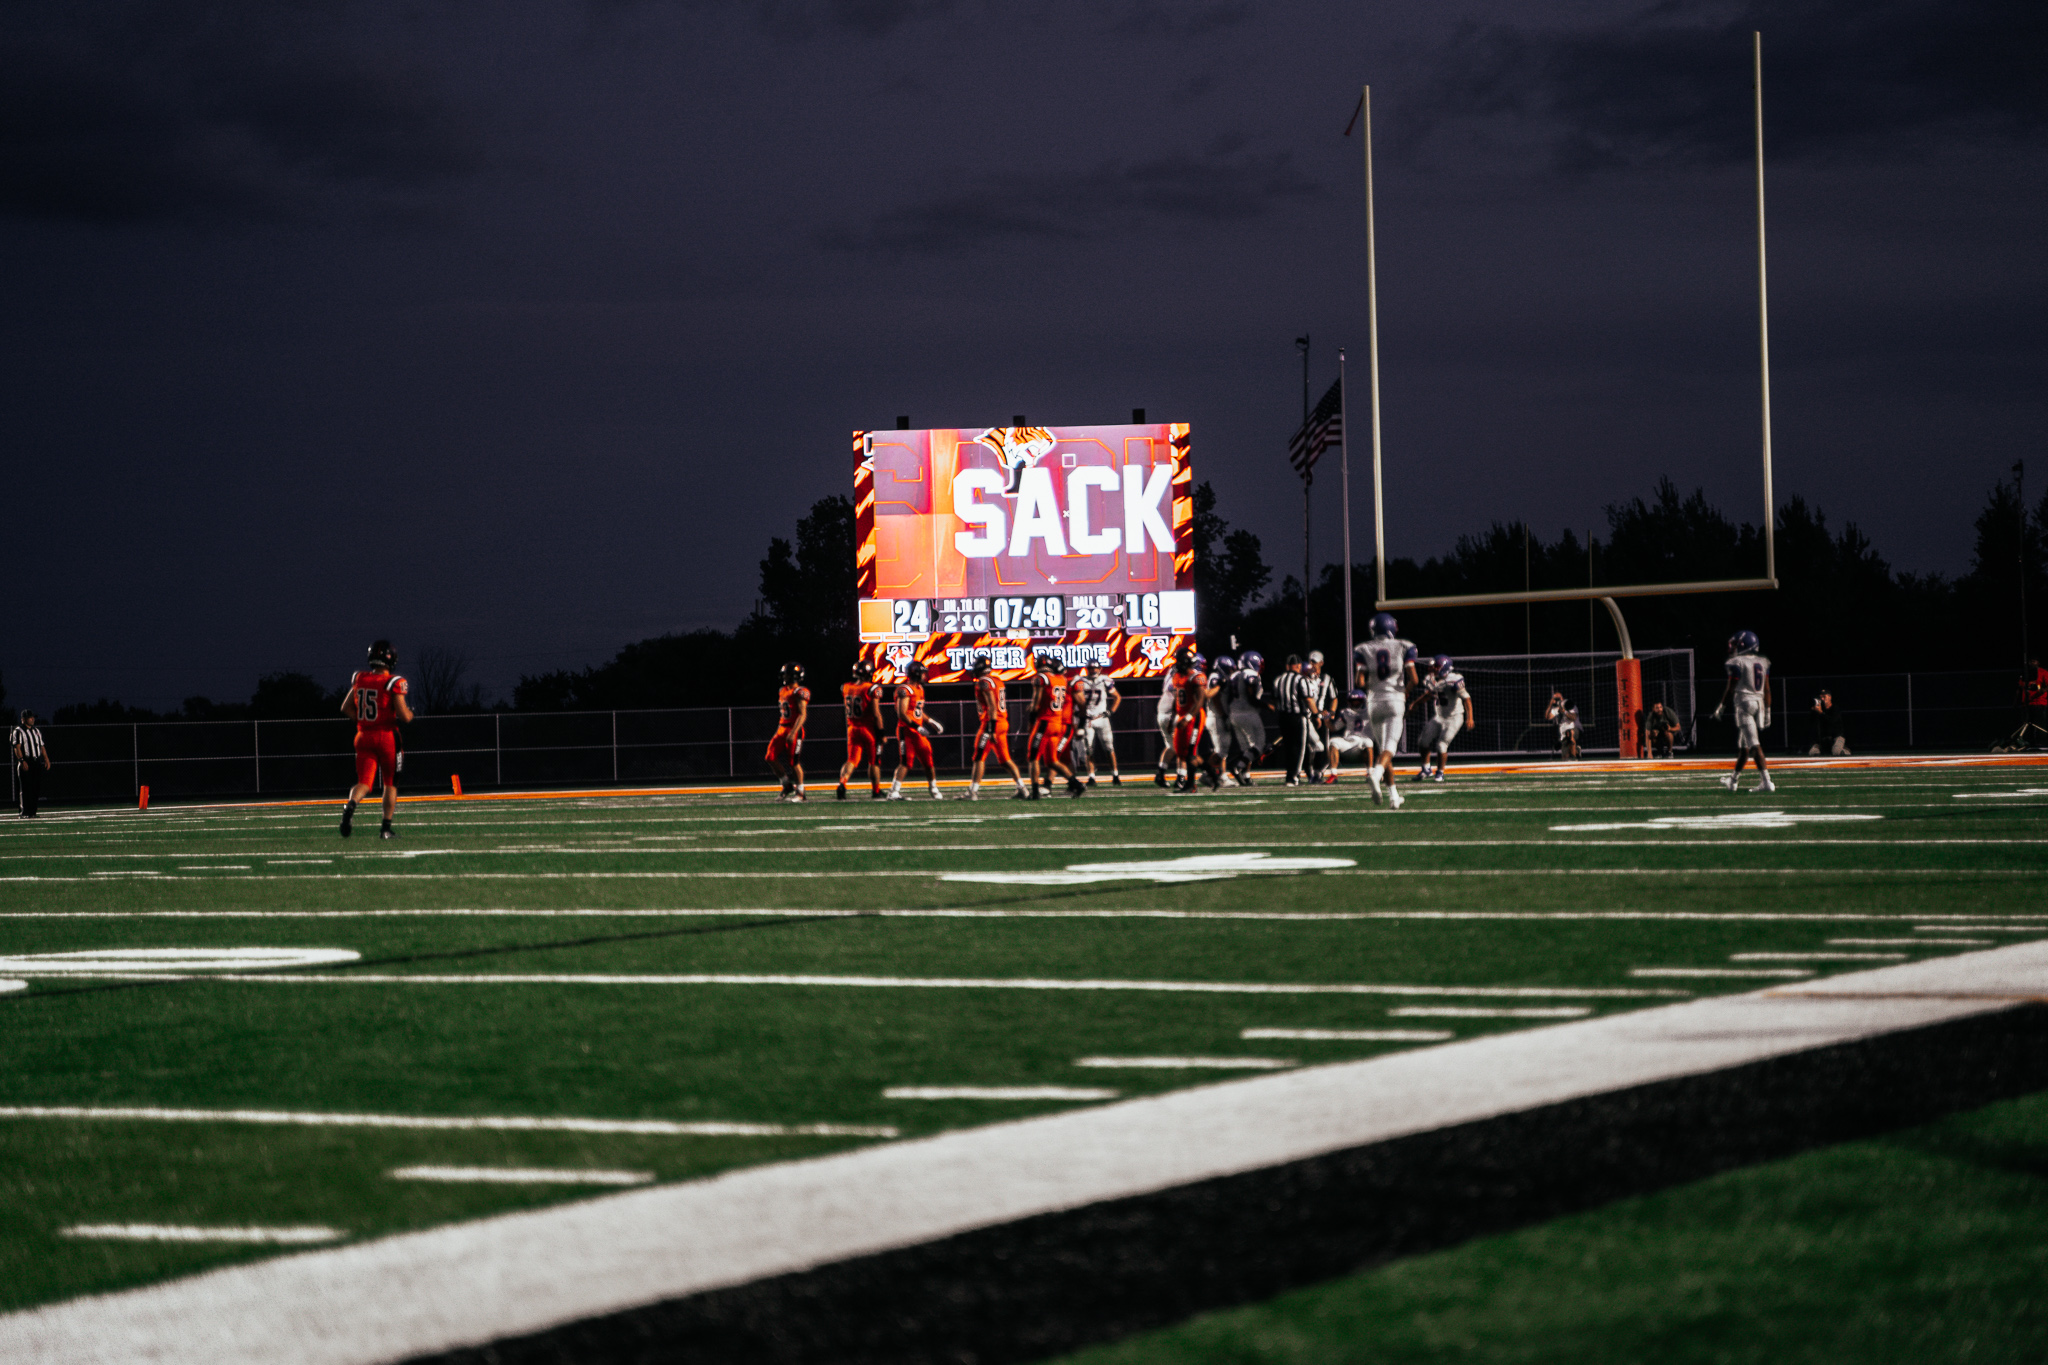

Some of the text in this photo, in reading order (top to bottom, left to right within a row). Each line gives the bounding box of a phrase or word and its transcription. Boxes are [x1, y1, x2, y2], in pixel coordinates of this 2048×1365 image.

[953, 464, 1176, 558] SACK
[894, 600, 930, 633] 24
[944, 614, 987, 632] 2 10
[993, 597, 1063, 629] 07:49
[1075, 608, 1108, 629] 20
[1125, 593, 1159, 627] 16
[1376, 648, 1391, 681] 8
[1753, 662, 1764, 692] 6
[356, 687, 378, 722] 15
[1620, 678, 1631, 742] TECH
